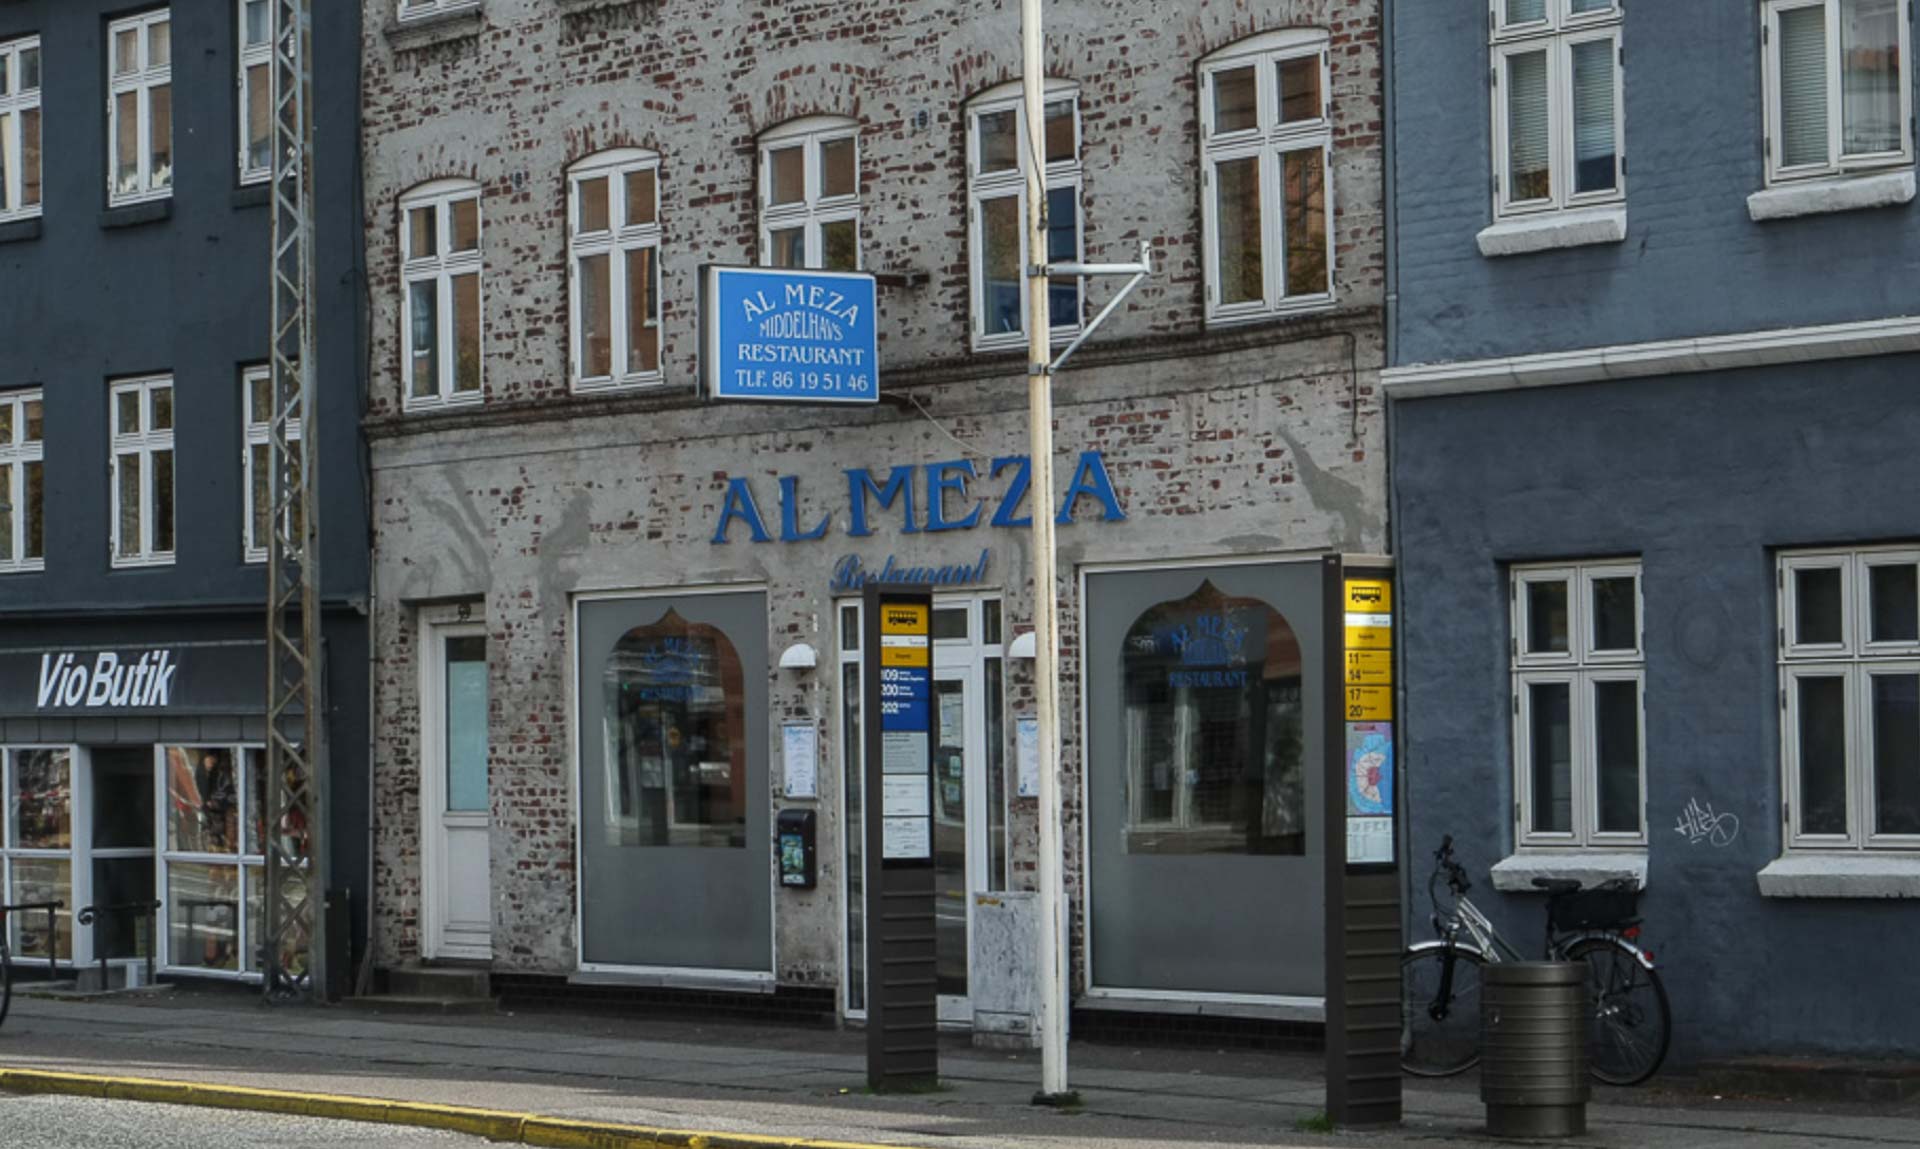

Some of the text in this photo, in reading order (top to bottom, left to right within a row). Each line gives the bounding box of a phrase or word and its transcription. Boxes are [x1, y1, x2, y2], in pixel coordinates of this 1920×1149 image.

[742, 284, 859, 328] AL MEZA
[738, 343, 864, 366] RESTAURANT
[735, 369, 868, 392] TLF. 86 19 51 46
[710, 450, 1128, 544] AL MEZA
[1349, 687, 1362, 701] 17
[1349, 704, 1364, 718] 20
